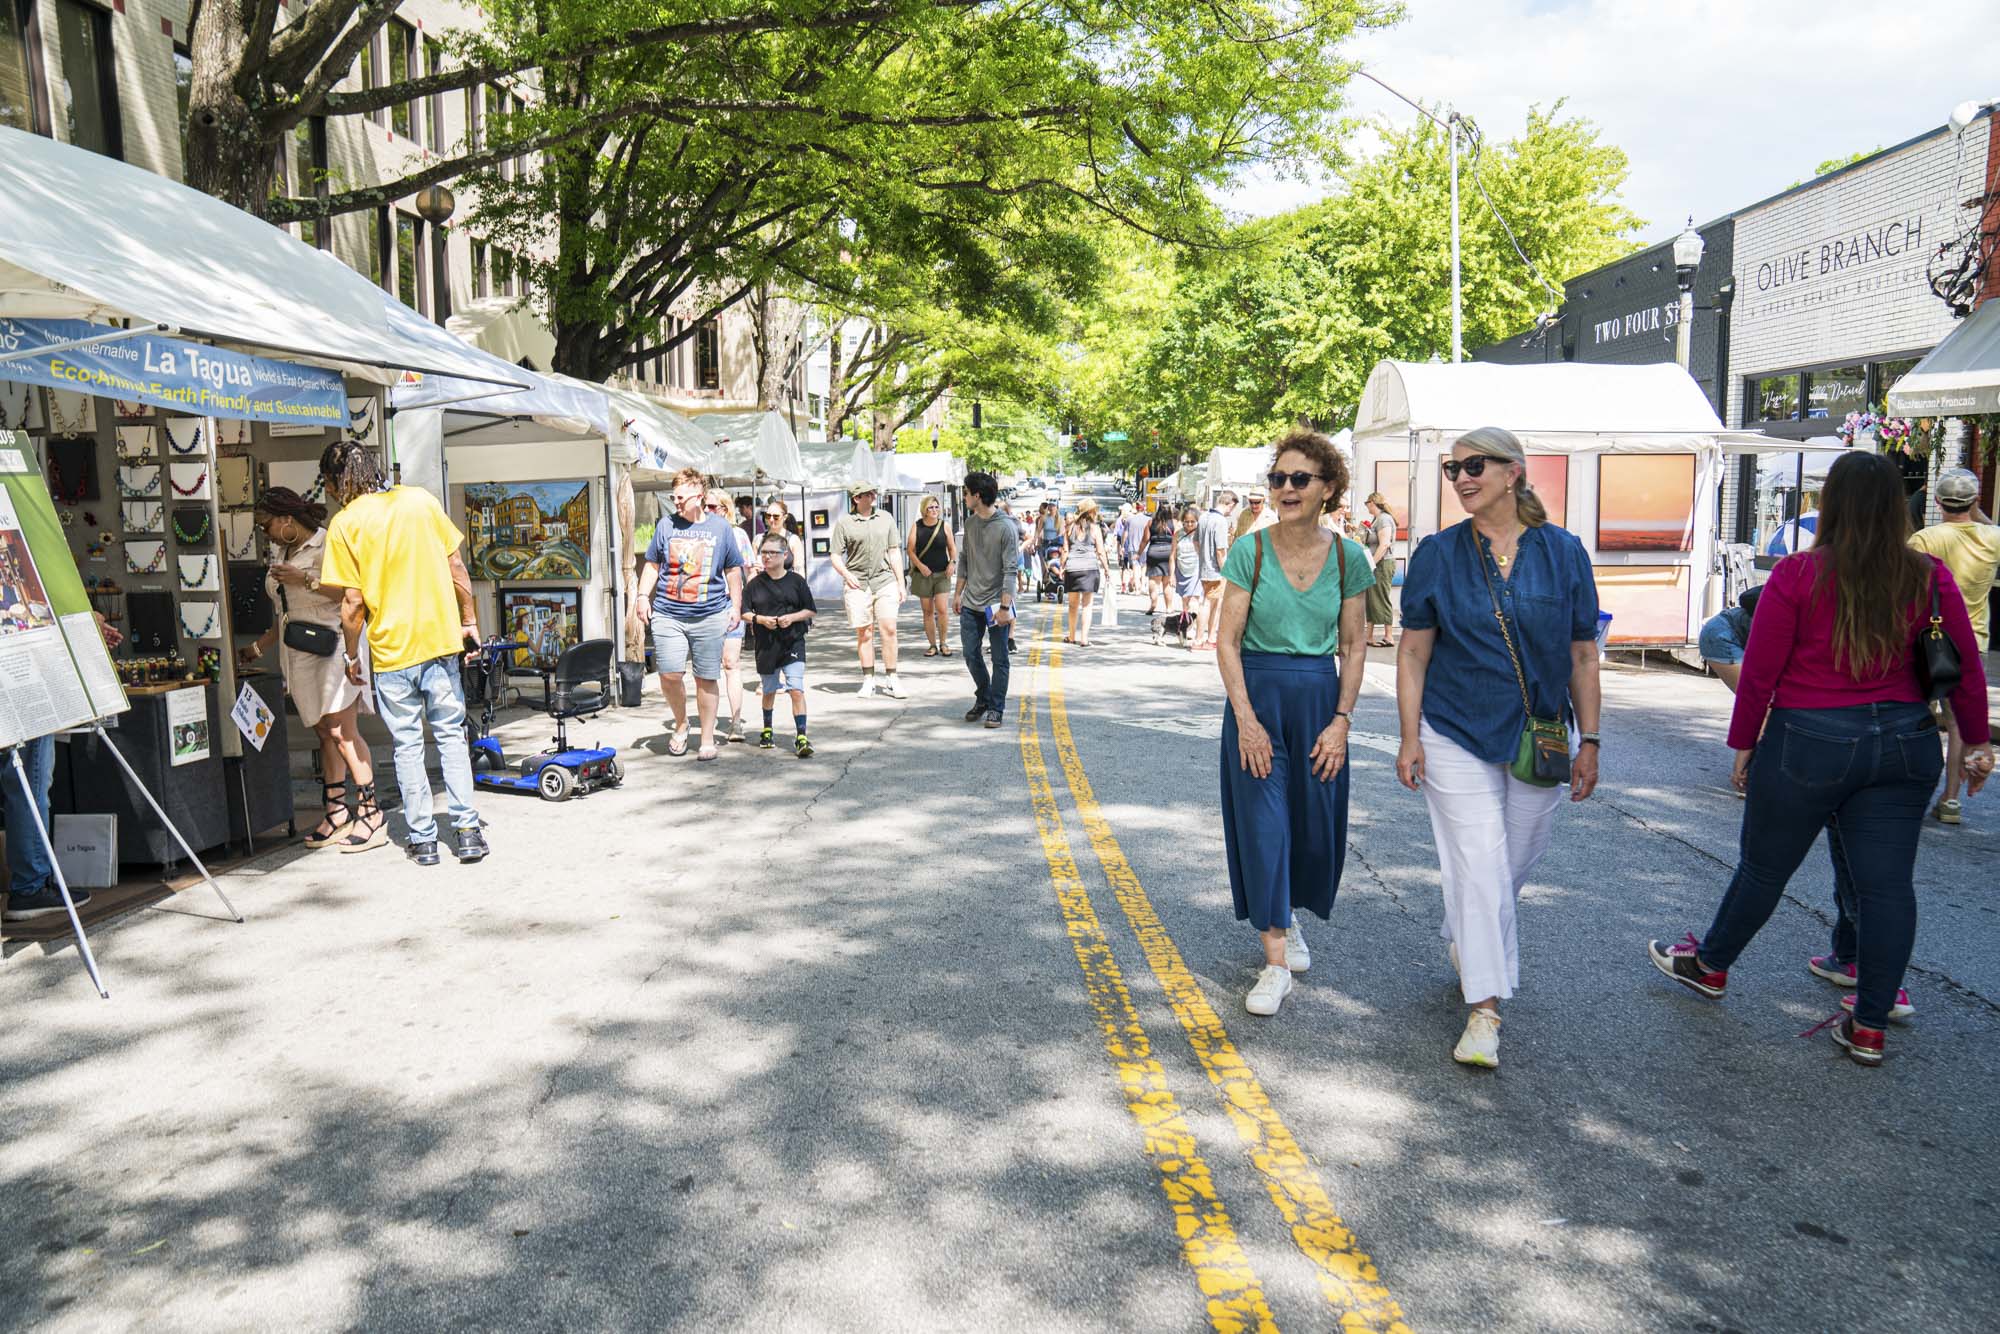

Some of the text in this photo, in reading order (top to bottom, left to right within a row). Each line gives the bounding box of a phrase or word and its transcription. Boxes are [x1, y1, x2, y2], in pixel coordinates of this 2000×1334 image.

[1757, 215, 1923, 292] OLIVE BRANCH
[1594, 318, 1620, 344] TWO
[1625, 307, 1660, 336] FOUR
[143, 341, 177, 376] La
[183, 348, 253, 389] Tagua
[200, 388, 252, 415] Friendly
[253, 401, 274, 413] and
[275, 400, 342, 420] Sustainable
[672, 529, 713, 539] FOREVER
[244, 687, 253, 701] 13
